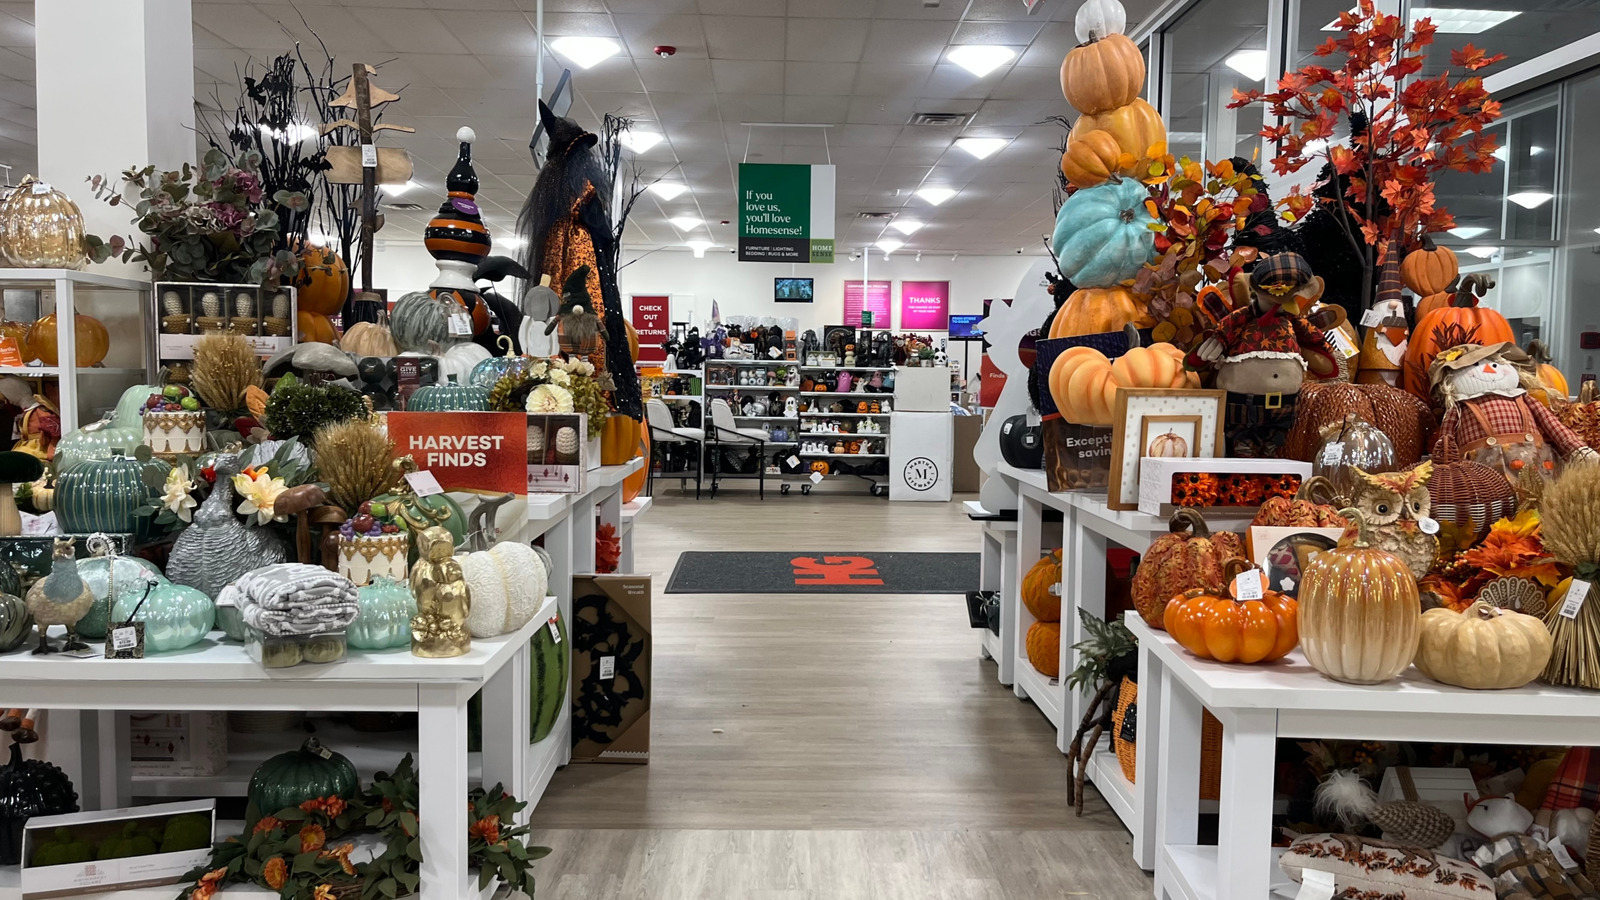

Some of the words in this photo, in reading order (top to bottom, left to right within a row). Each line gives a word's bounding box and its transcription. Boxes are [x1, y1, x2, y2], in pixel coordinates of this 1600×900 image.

[746, 190, 753, 200] If
[755, 192, 773, 202] you
[746, 202, 765, 211] love
[767, 204, 781, 212] us,
[746, 213, 770, 224] you'll
[771, 213, 791, 223] love
[745, 225, 803, 235] Homesense!
[409, 435, 504, 450] HARVEST
[1066, 433, 1113, 448] Excepti
[1078, 446, 1112, 458] savin
[427, 452, 487, 467] FINDS
[916, 468, 927, 480] M
